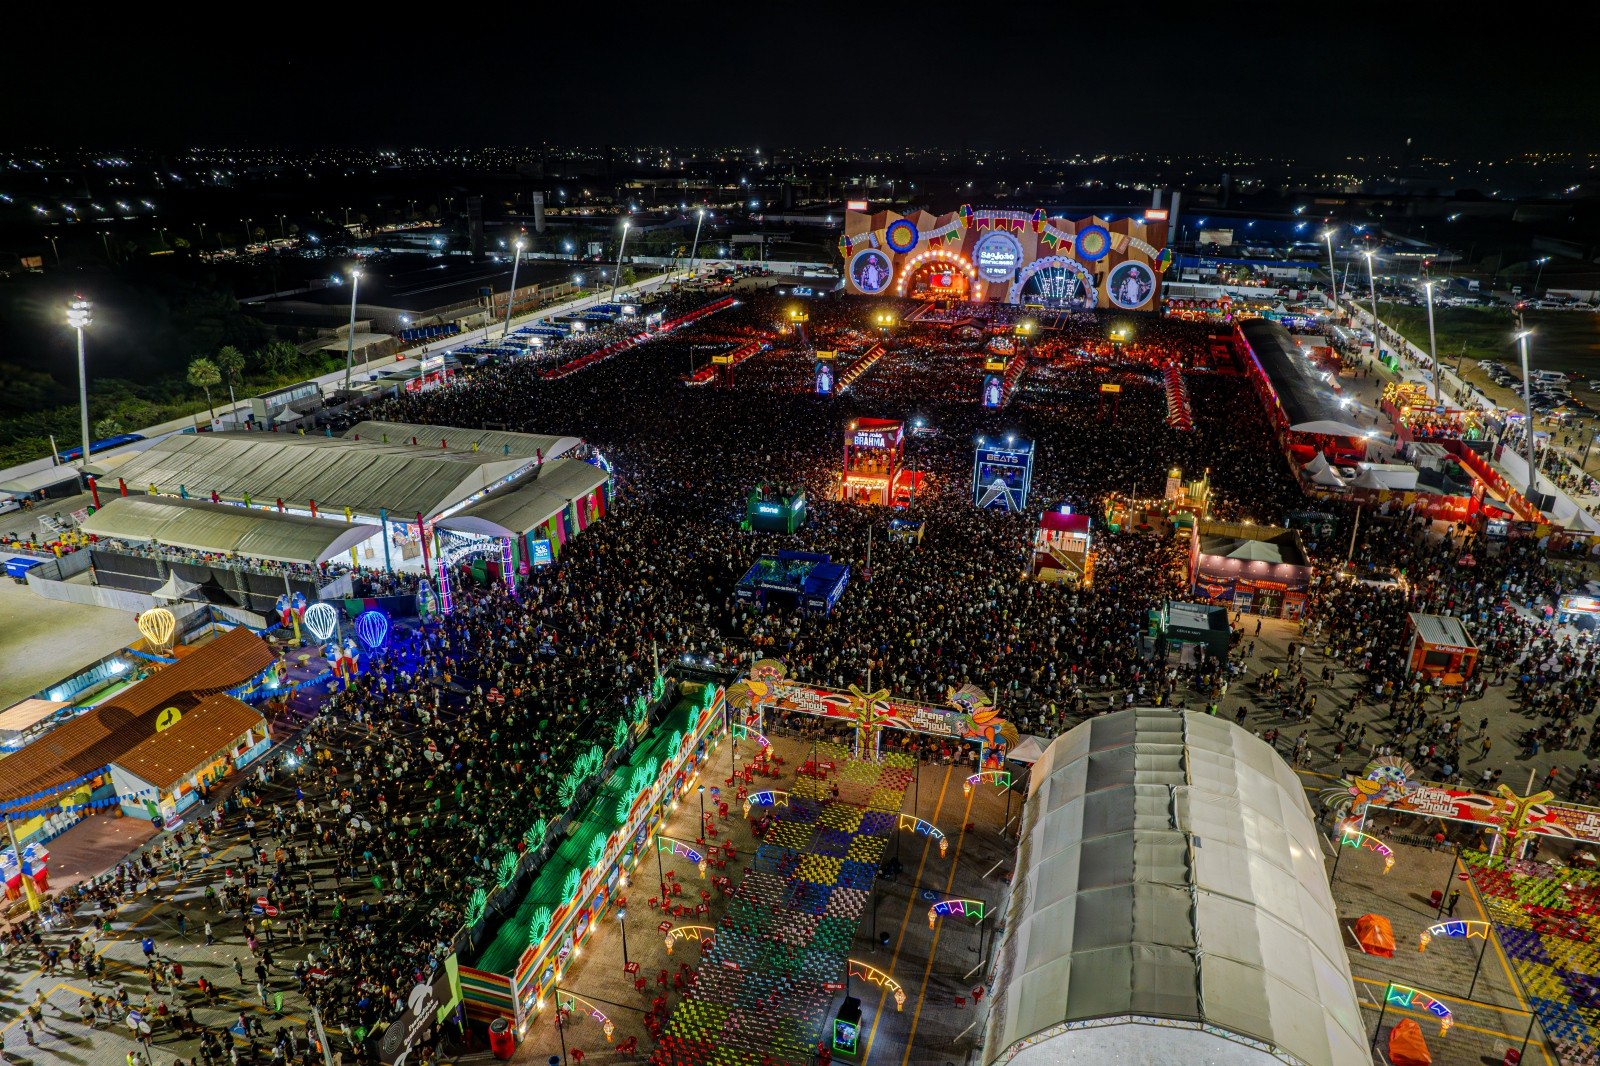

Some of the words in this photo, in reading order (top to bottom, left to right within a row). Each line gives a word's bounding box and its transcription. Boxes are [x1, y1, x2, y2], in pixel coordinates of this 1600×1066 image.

[854, 436, 885, 447] BRAHMA
[986, 453, 1019, 464] BEATS
[759, 506, 779, 514] stone
[794, 688, 820, 702] Arena
[917, 708, 944, 722] Arena
[1417, 787, 1451, 804] Arena
